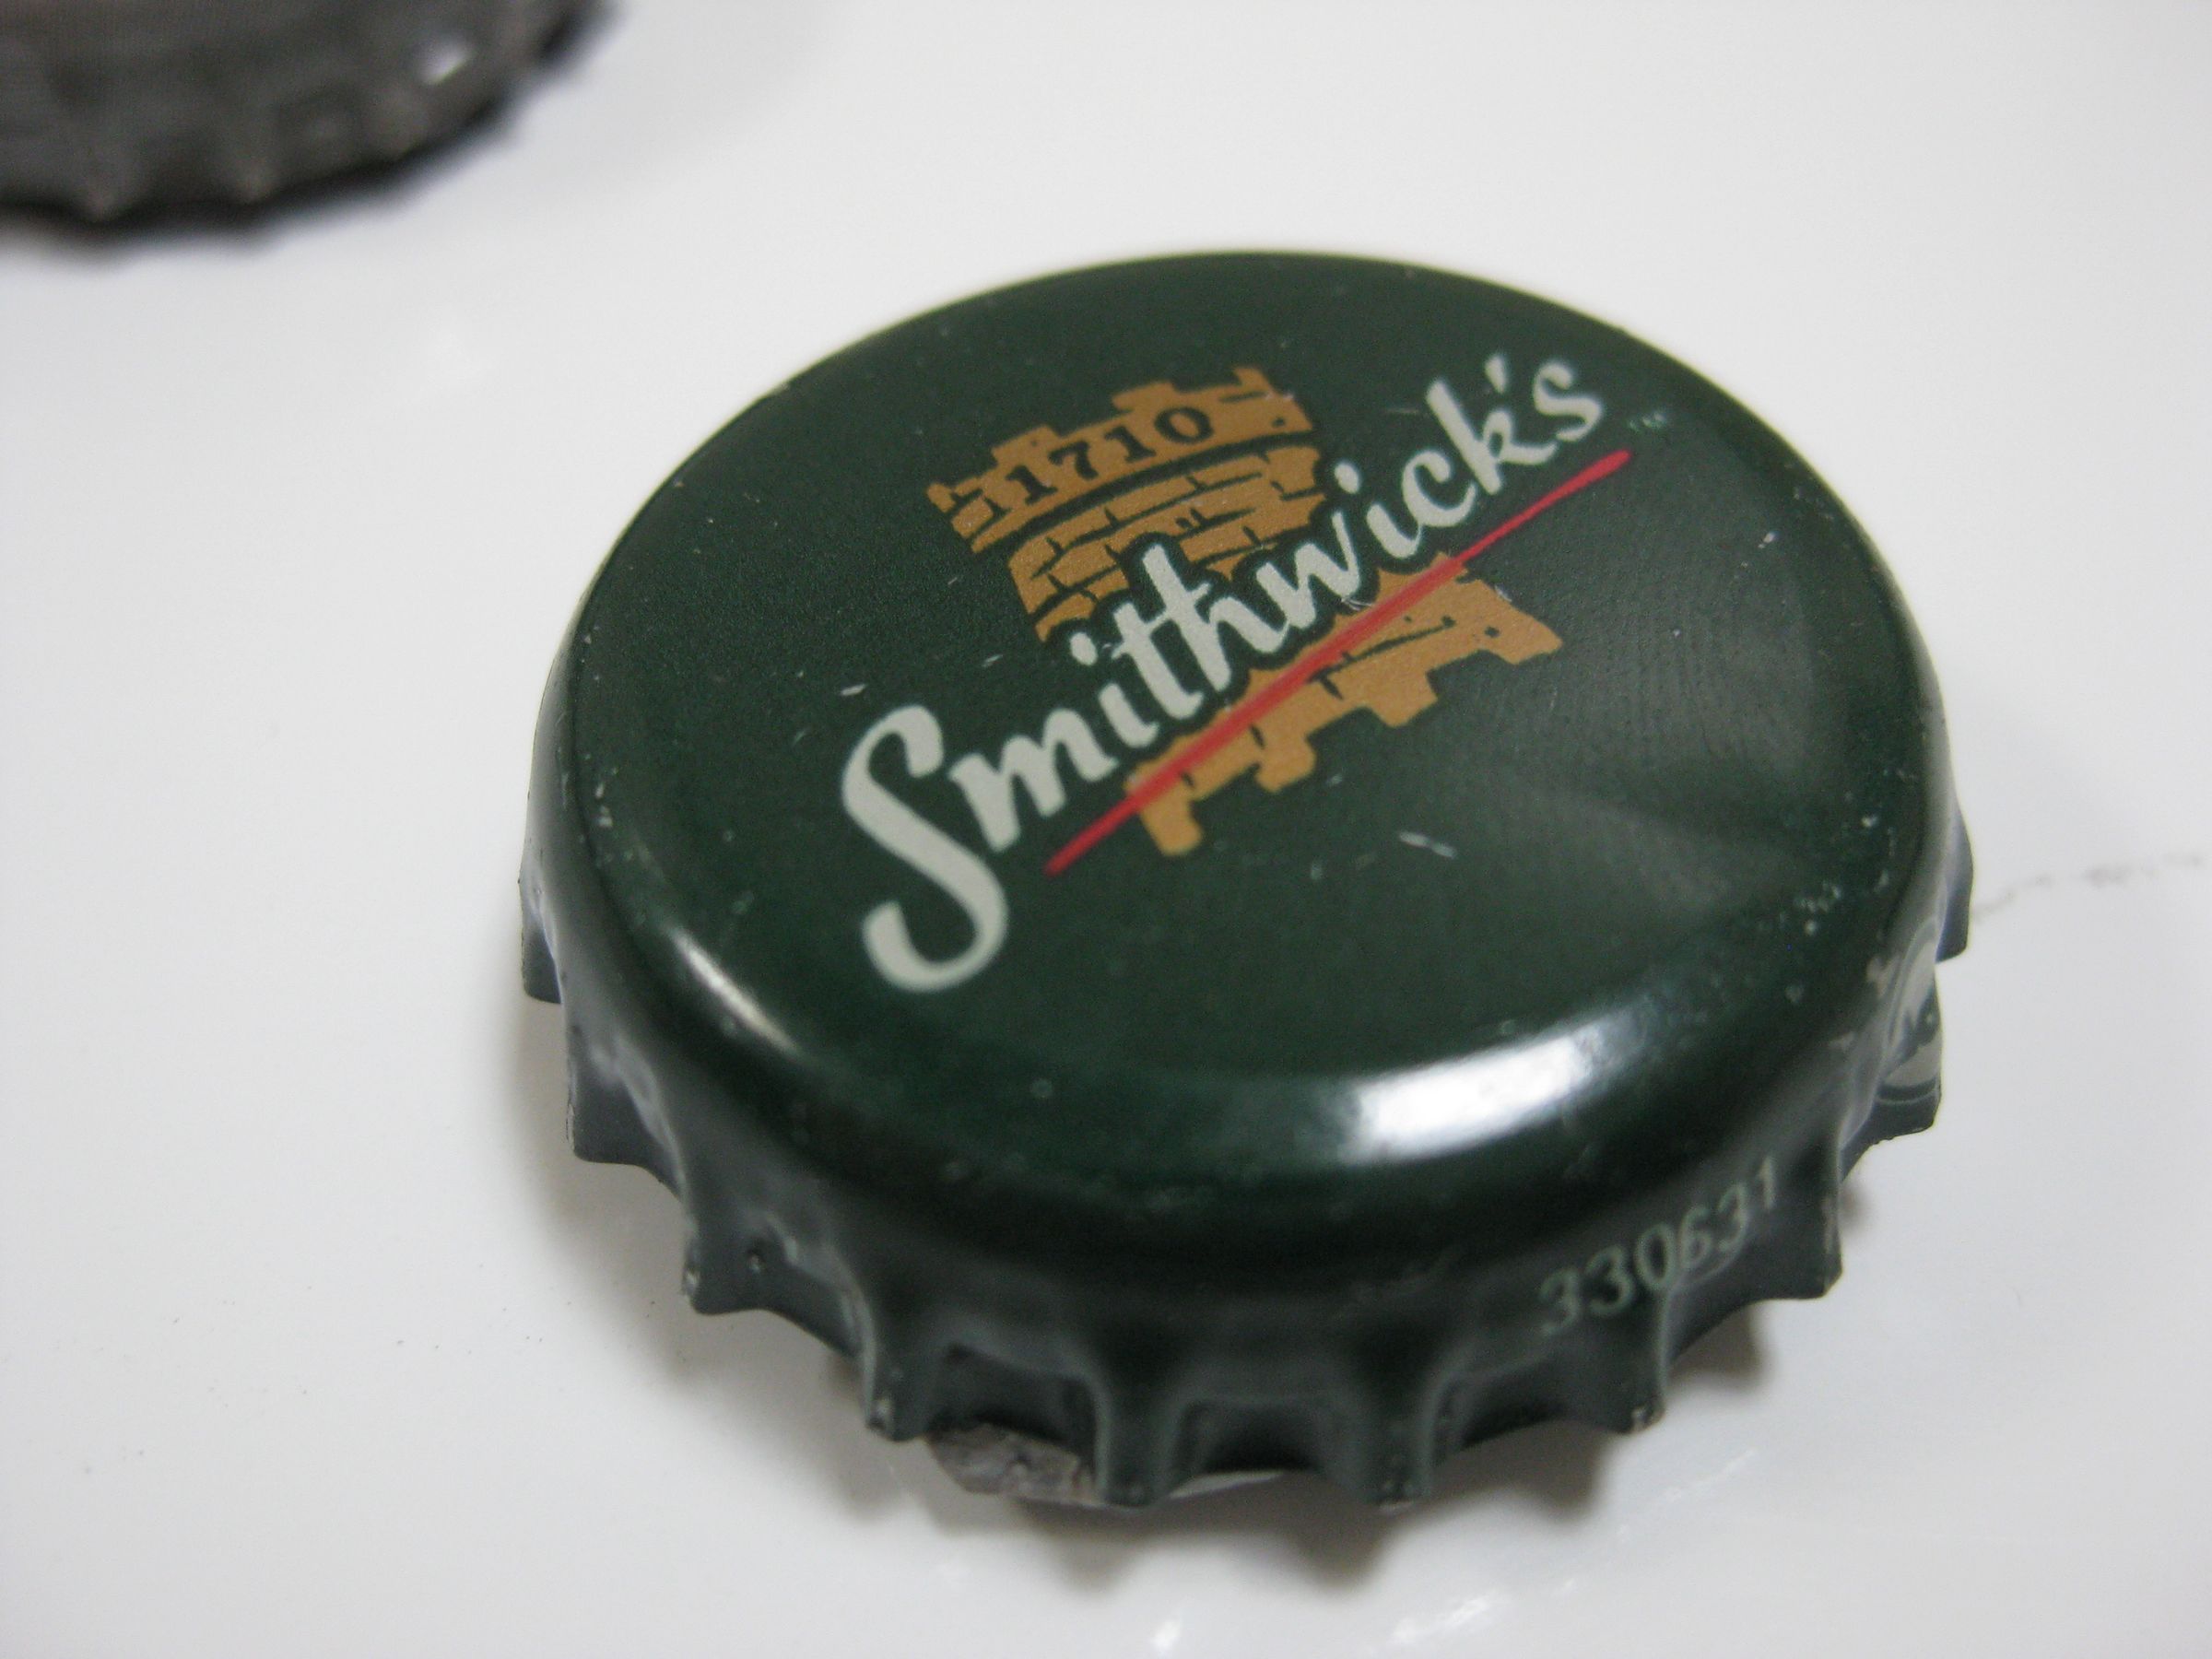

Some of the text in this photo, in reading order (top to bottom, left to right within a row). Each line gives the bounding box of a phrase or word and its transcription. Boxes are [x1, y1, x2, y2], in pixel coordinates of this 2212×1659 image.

[1006, 406, 1214, 506] 1710
[840, 353, 1605, 993] Smithwick's
[1538, 1155, 1776, 1337] 330631
